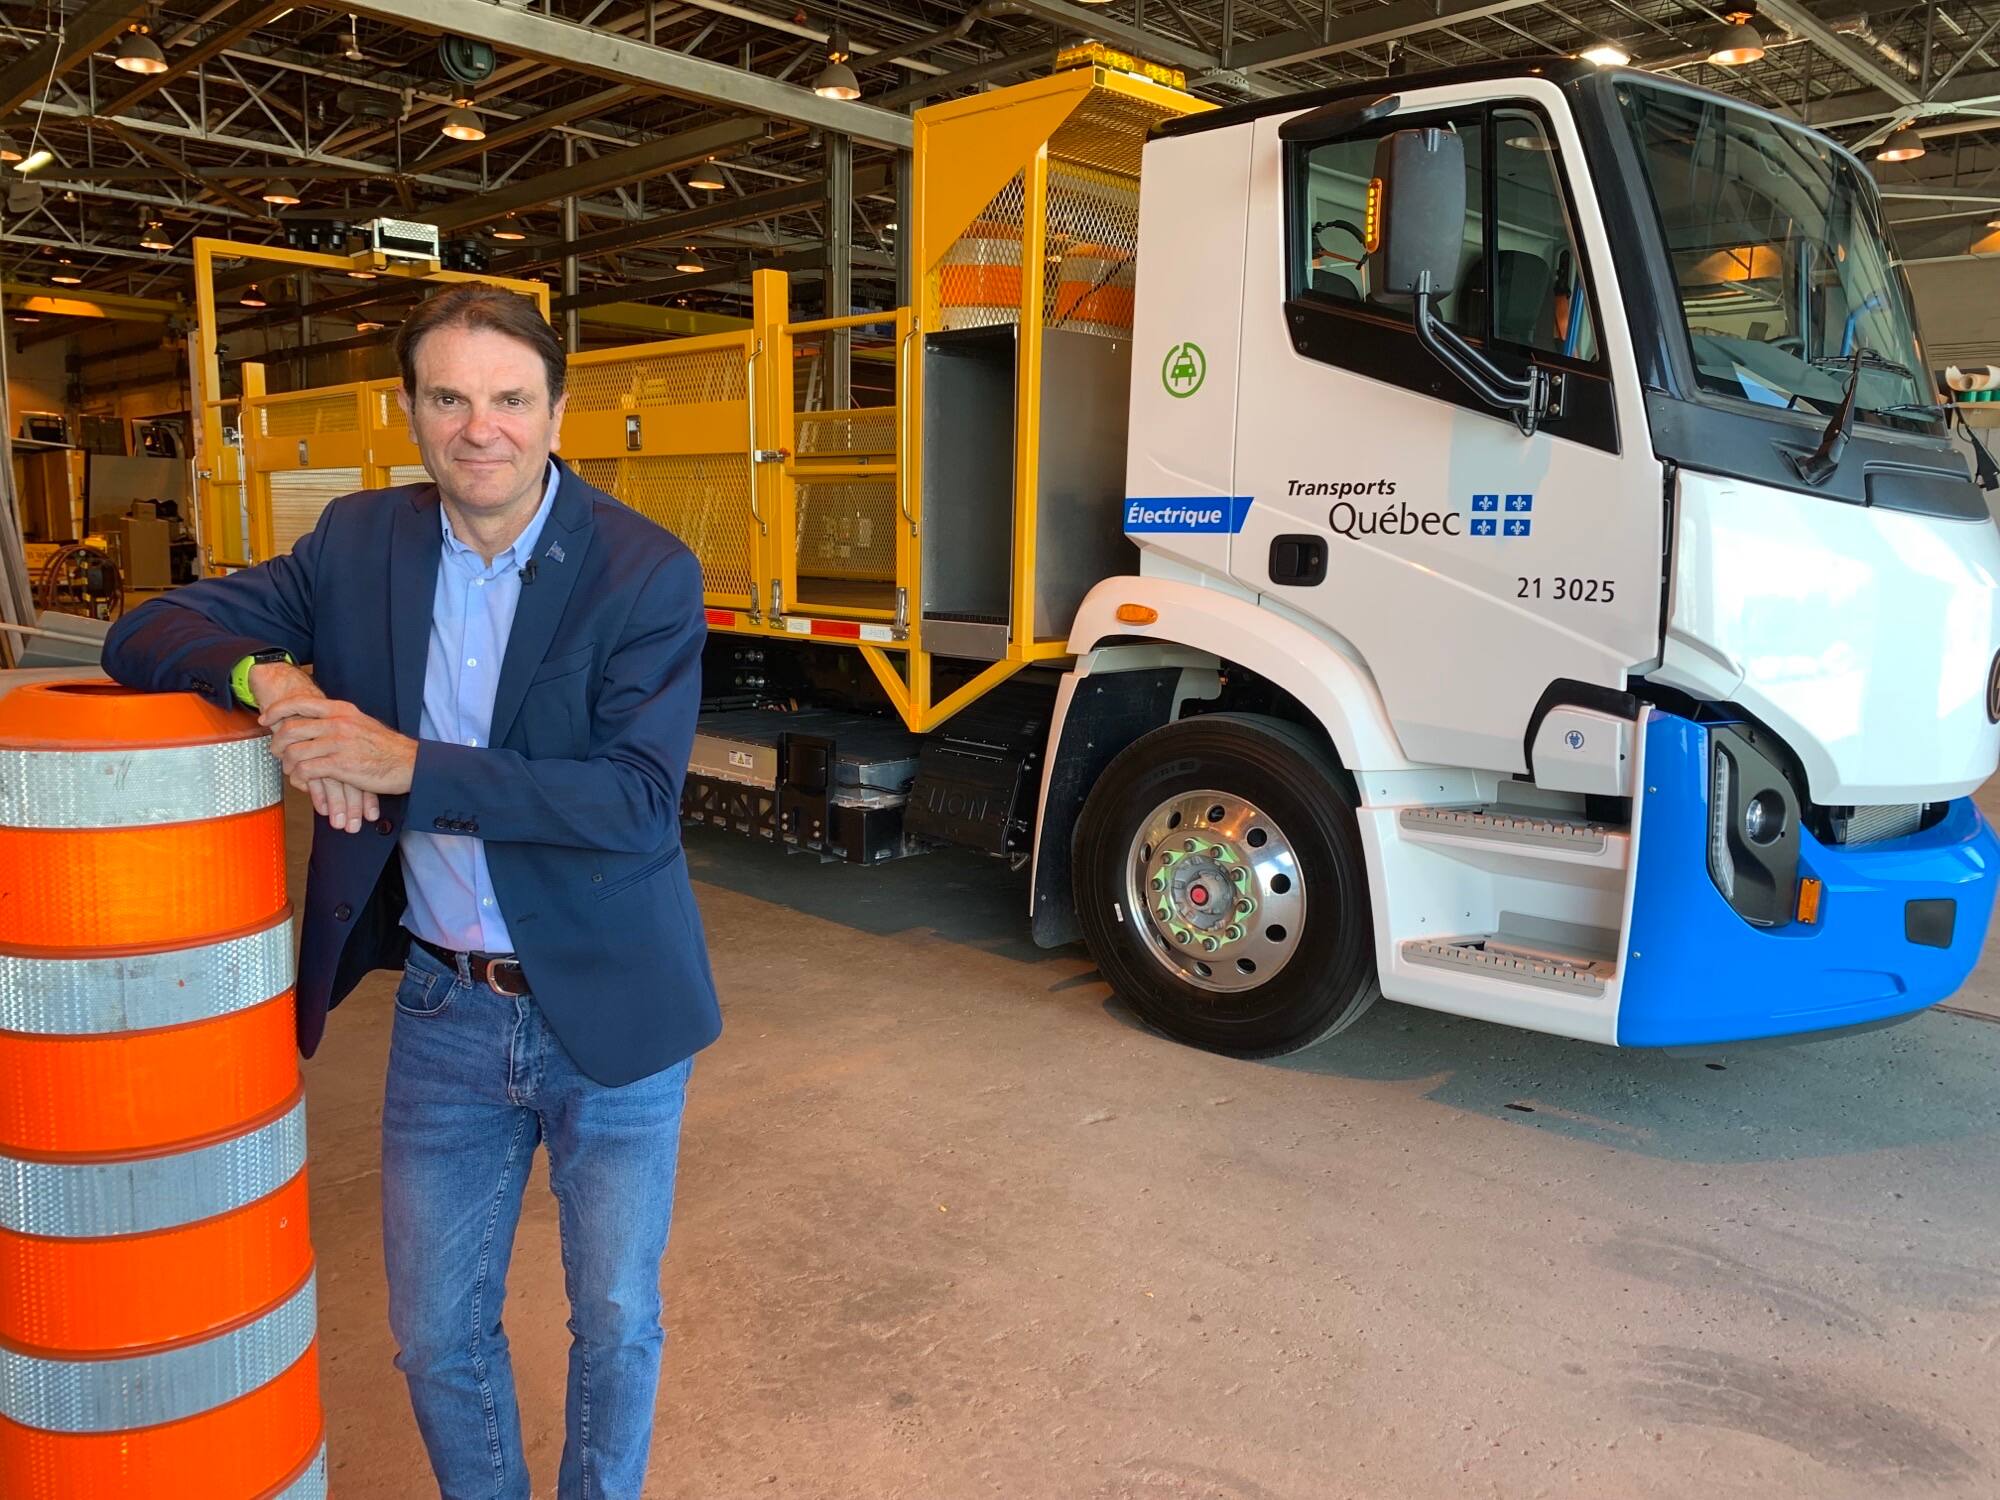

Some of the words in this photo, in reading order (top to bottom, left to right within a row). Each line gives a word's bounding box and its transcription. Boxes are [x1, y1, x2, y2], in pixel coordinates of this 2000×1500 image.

[1288, 479, 1396, 499] Transports
[1127, 502, 1222, 528] Électrique
[1329, 502, 1461, 540] Québec
[1517, 577, 1540, 598] 21
[1553, 577, 1615, 602] 3025
